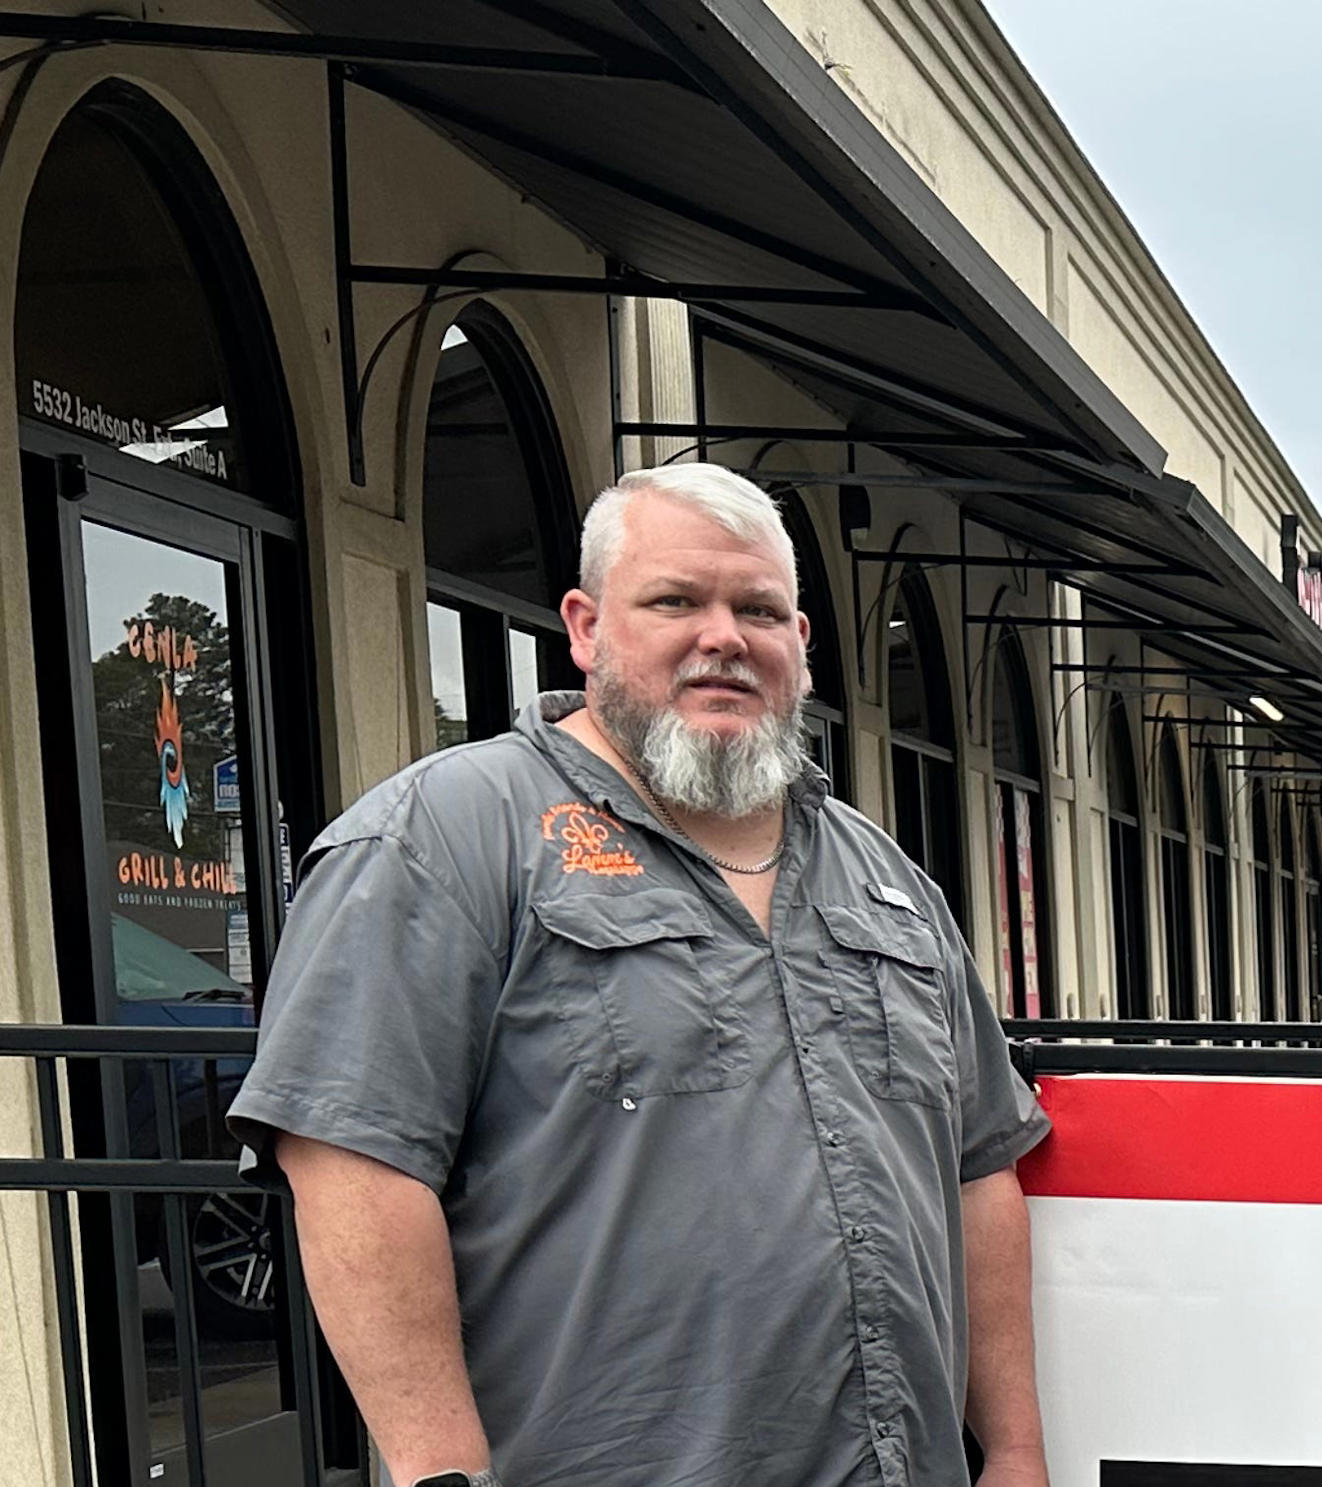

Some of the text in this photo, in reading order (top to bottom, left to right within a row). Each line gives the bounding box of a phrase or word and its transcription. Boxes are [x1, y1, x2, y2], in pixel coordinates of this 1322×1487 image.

[33, 379, 73, 424] 5532
[75, 396, 130, 444] Jackson
[217, 450, 228, 480] A
[128, 622, 198, 672] CENLA
[118, 852, 237, 895] GRILL & CHILL
